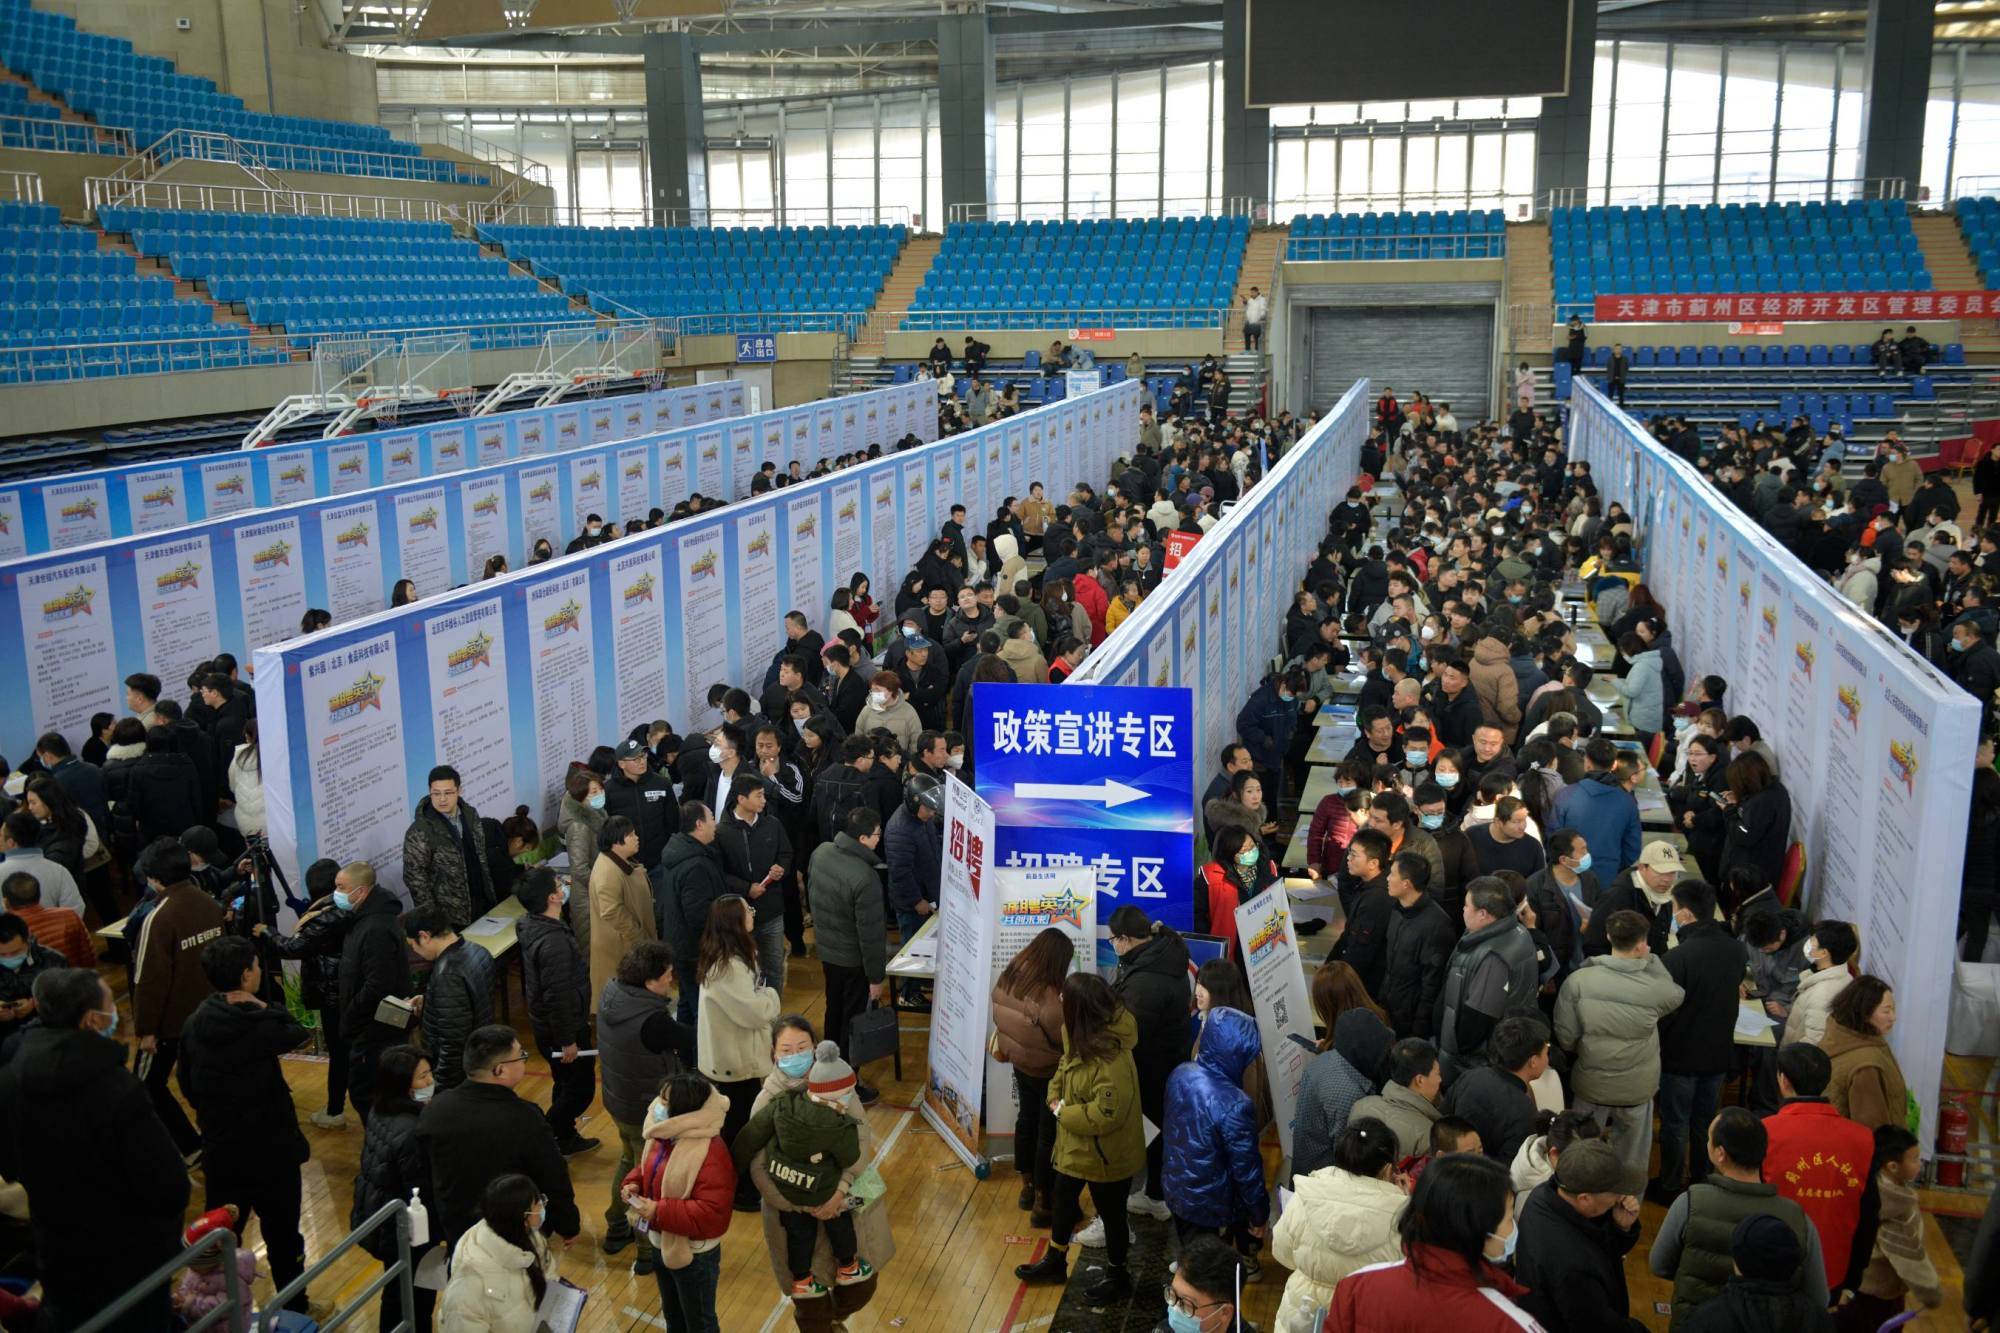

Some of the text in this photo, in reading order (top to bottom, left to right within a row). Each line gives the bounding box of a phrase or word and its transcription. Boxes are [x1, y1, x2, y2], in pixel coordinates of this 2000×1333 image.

[755, 338, 774, 348] 应急
[756, 348, 774, 358] 出口
[992, 709, 1177, 758] 政策宣讲专区
[949, 816, 984, 879] 招聘
[770, 1160, 776, 1174] I
[776, 1164, 804, 1186] LOST
